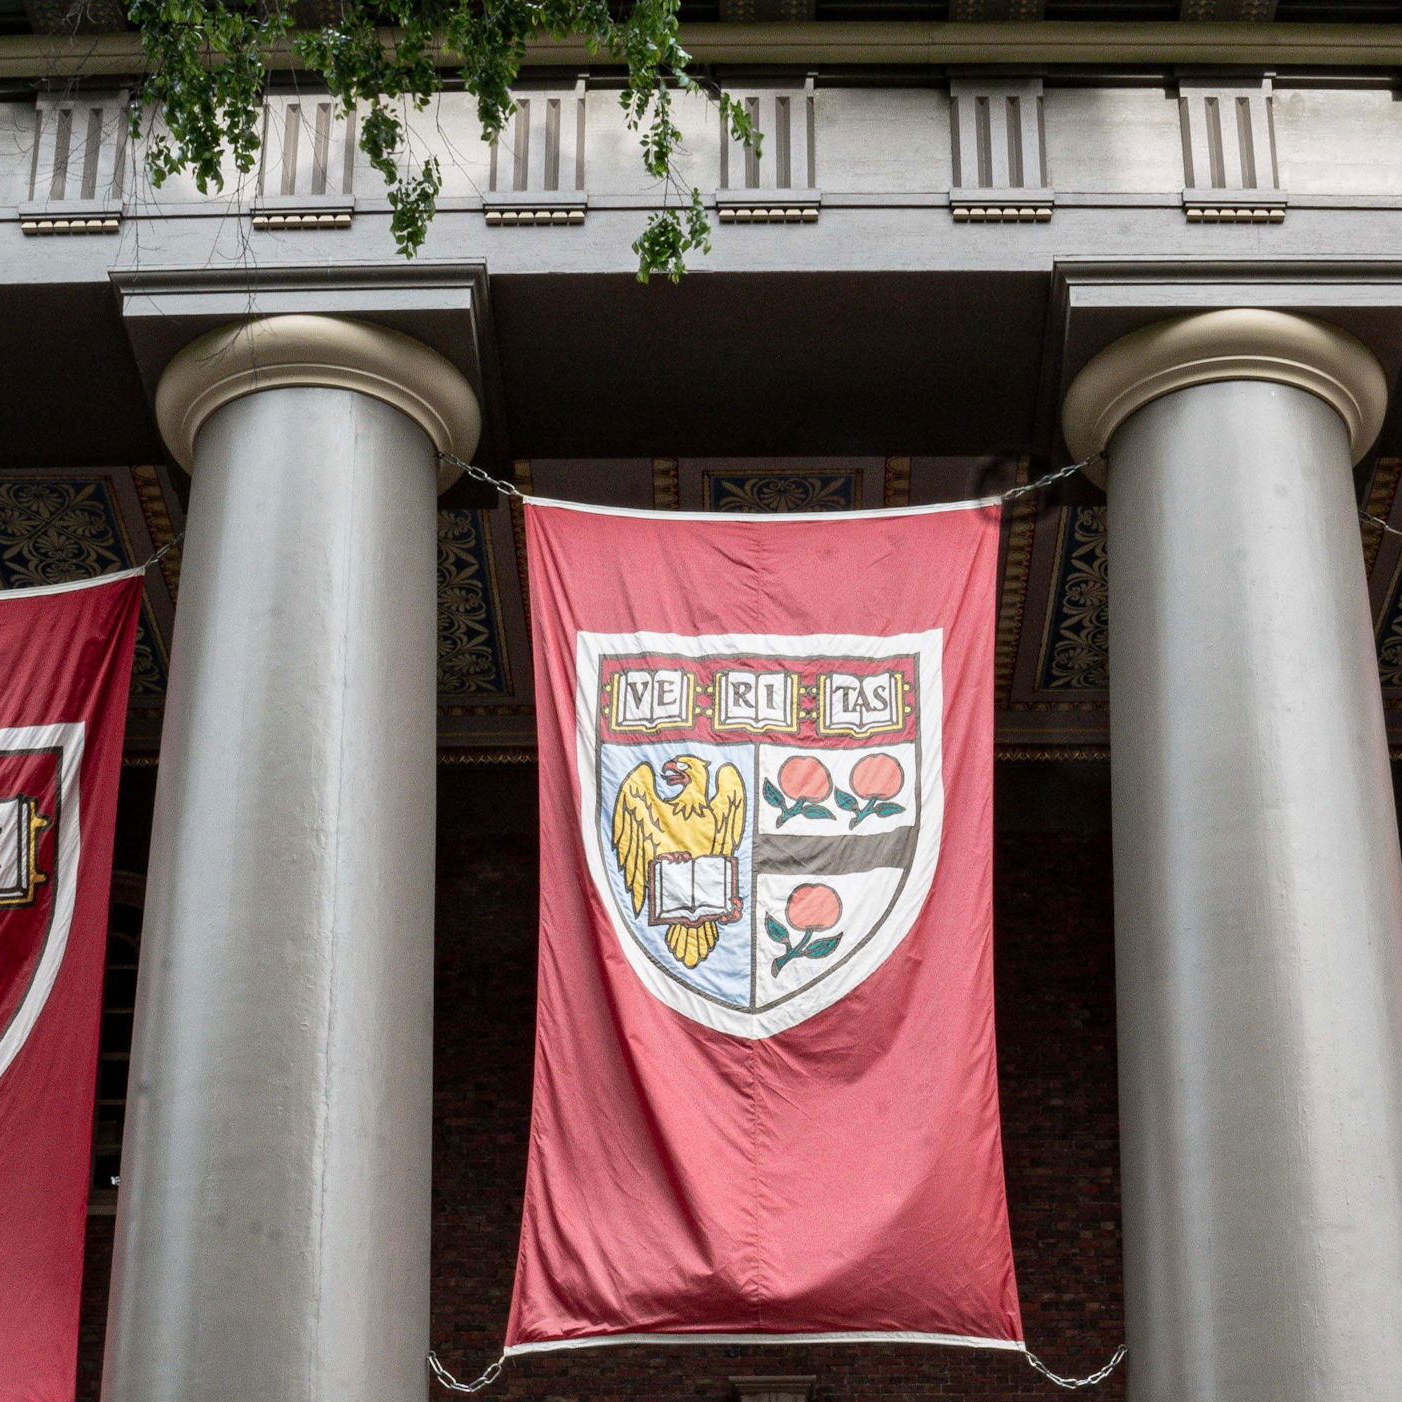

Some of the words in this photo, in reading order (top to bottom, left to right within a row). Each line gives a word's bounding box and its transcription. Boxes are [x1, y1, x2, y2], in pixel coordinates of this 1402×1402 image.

[627, 678, 676, 709] VE
[730, 681, 777, 709] RI
[834, 683, 890, 713] TAS
